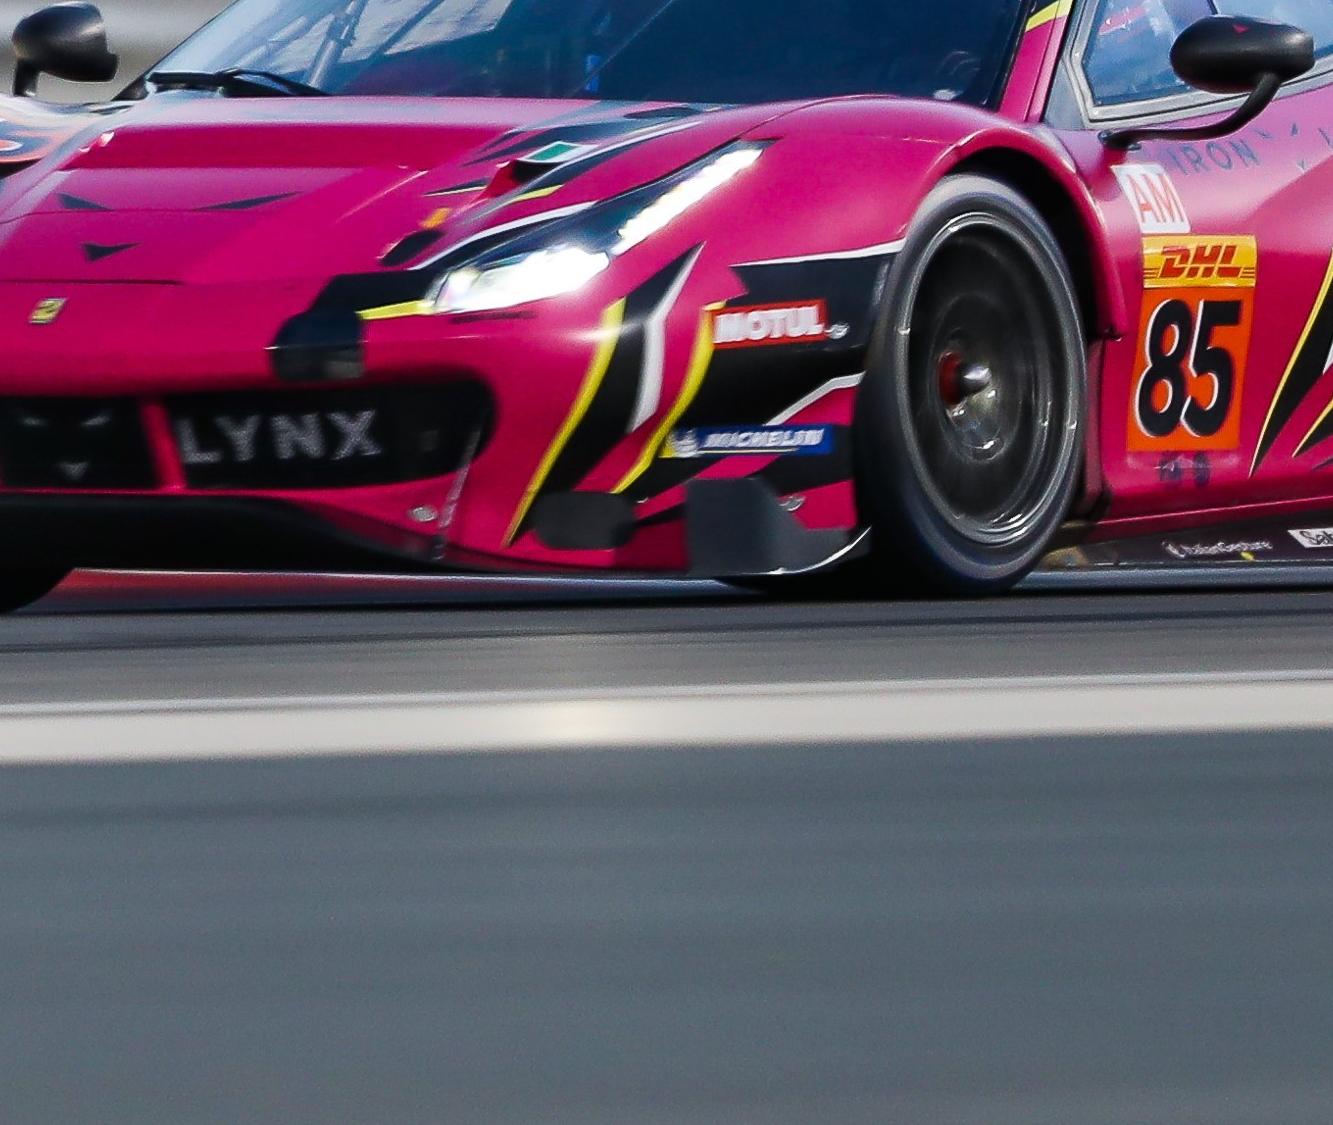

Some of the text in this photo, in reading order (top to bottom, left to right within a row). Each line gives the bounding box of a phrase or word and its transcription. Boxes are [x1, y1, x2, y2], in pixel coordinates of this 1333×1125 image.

[1168, 138, 1260, 177] IRON
[1127, 174, 1185, 225] AM
[1159, 244, 1243, 279] DHL
[714, 306, 825, 343] MOTUL
[1134, 298, 1242, 438] 85
[174, 410, 383, 465] LYNX
[704, 429, 825, 448] MICHELIN
